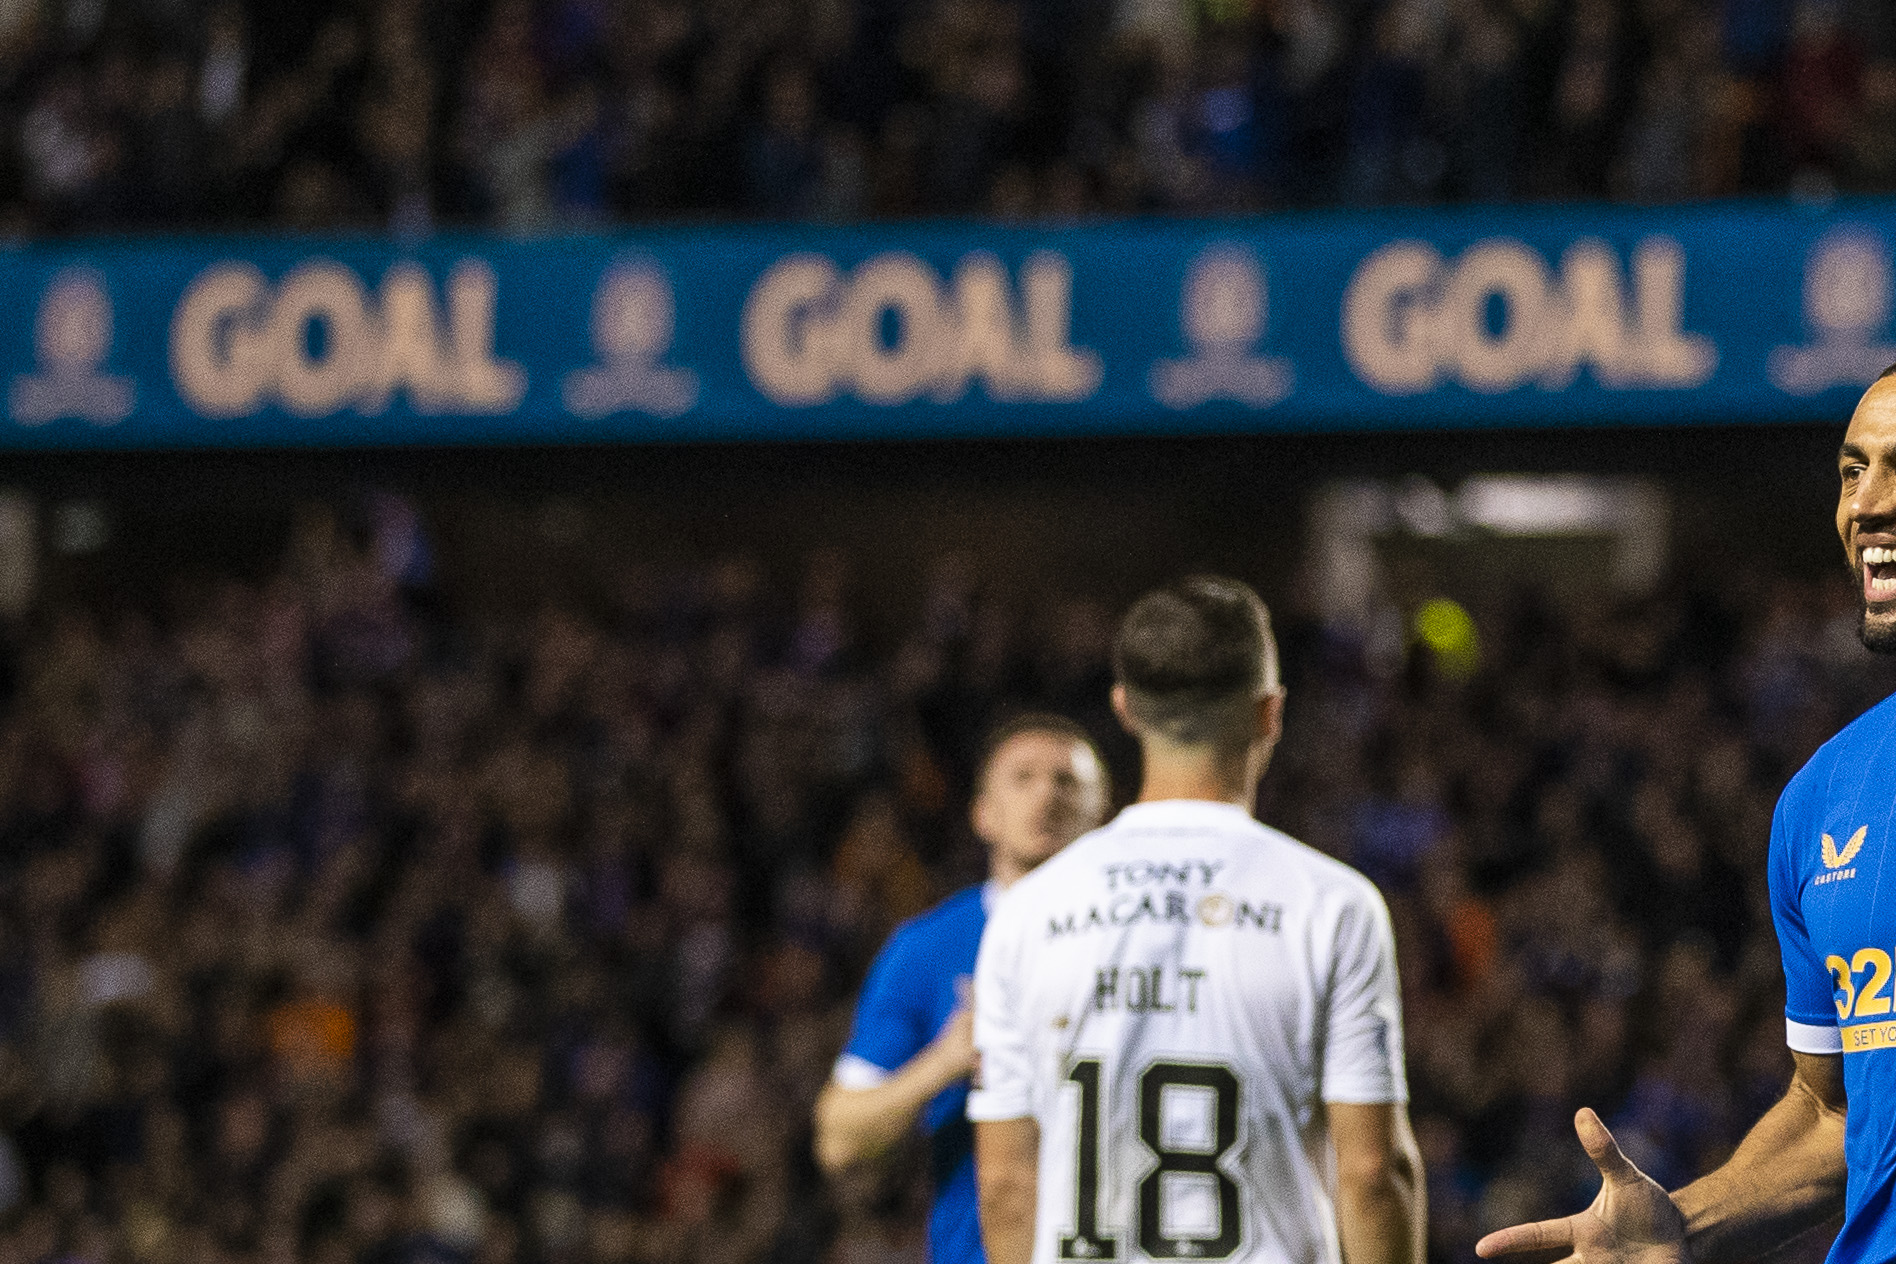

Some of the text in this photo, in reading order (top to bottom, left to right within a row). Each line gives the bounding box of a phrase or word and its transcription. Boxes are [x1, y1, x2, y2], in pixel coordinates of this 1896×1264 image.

[171, 258, 528, 416] GOAL
[743, 250, 1103, 406] GOAL
[1341, 234, 1717, 394] GOAL
[1045, 890, 1284, 941] MACARONI
[1102, 859, 1224, 889] TONY
[1095, 965, 1207, 1014] HOLT
[1854, 1027, 1877, 1046] SET
[1058, 1058, 1242, 1262] 18
